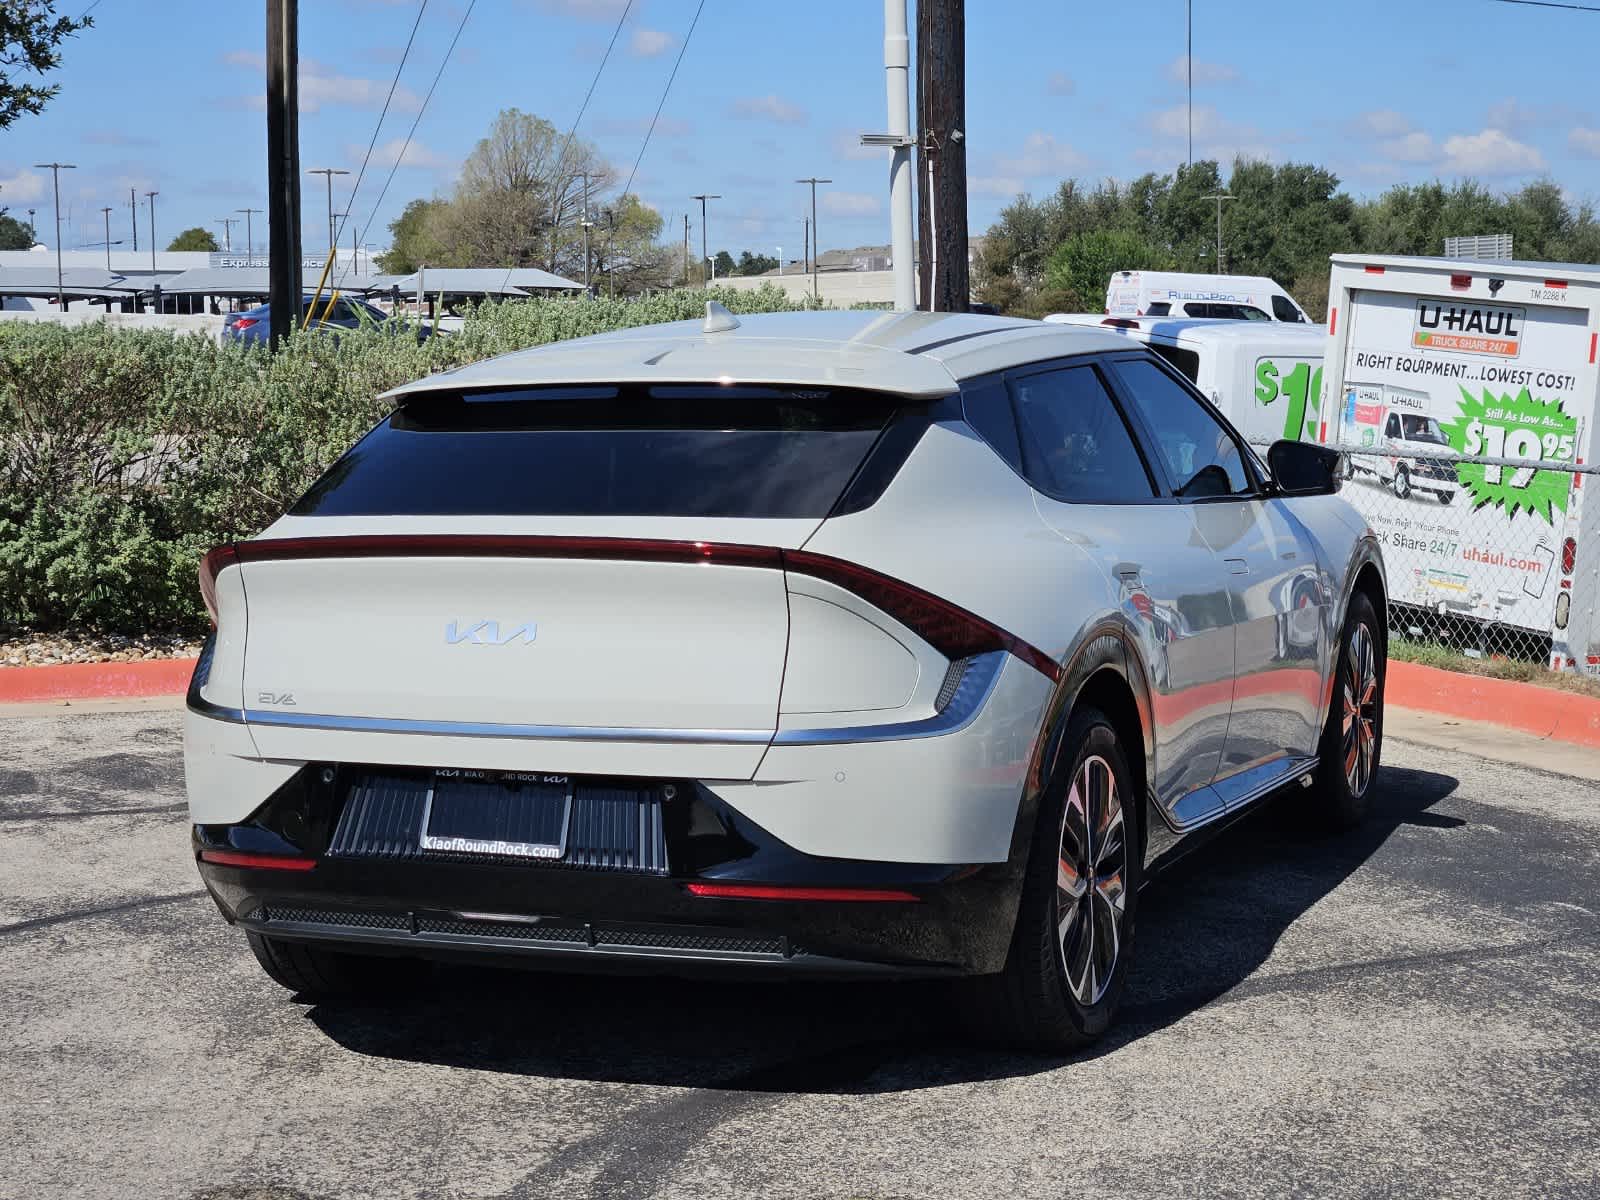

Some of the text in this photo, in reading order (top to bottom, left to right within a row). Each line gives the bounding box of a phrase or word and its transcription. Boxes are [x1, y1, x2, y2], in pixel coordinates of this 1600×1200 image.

[221, 258, 270, 269] Express
[1420, 305, 1518, 336] U-HAUL
[1431, 335, 1458, 348] TRUCK
[1459, 338, 1487, 352] SHARE
[1356, 352, 1392, 370] RIGHT
[1536, 372, 1576, 391] COST!
[1359, 391, 1380, 401] U-HAUL
[1391, 394, 1424, 409] U-HAUL
[1485, 407, 1504, 419] Still
[1505, 411, 1518, 421] As
[1520, 412, 1540, 425] Low
[1393, 533, 1427, 552] Share
[1429, 540, 1458, 560] 24/7
[1463, 546, 1543, 574] uhaul.com
[445, 620, 538, 645] KIA
[258, 691, 297, 706] EV6
[423, 836, 560, 859] KiaofRoundRock.com
